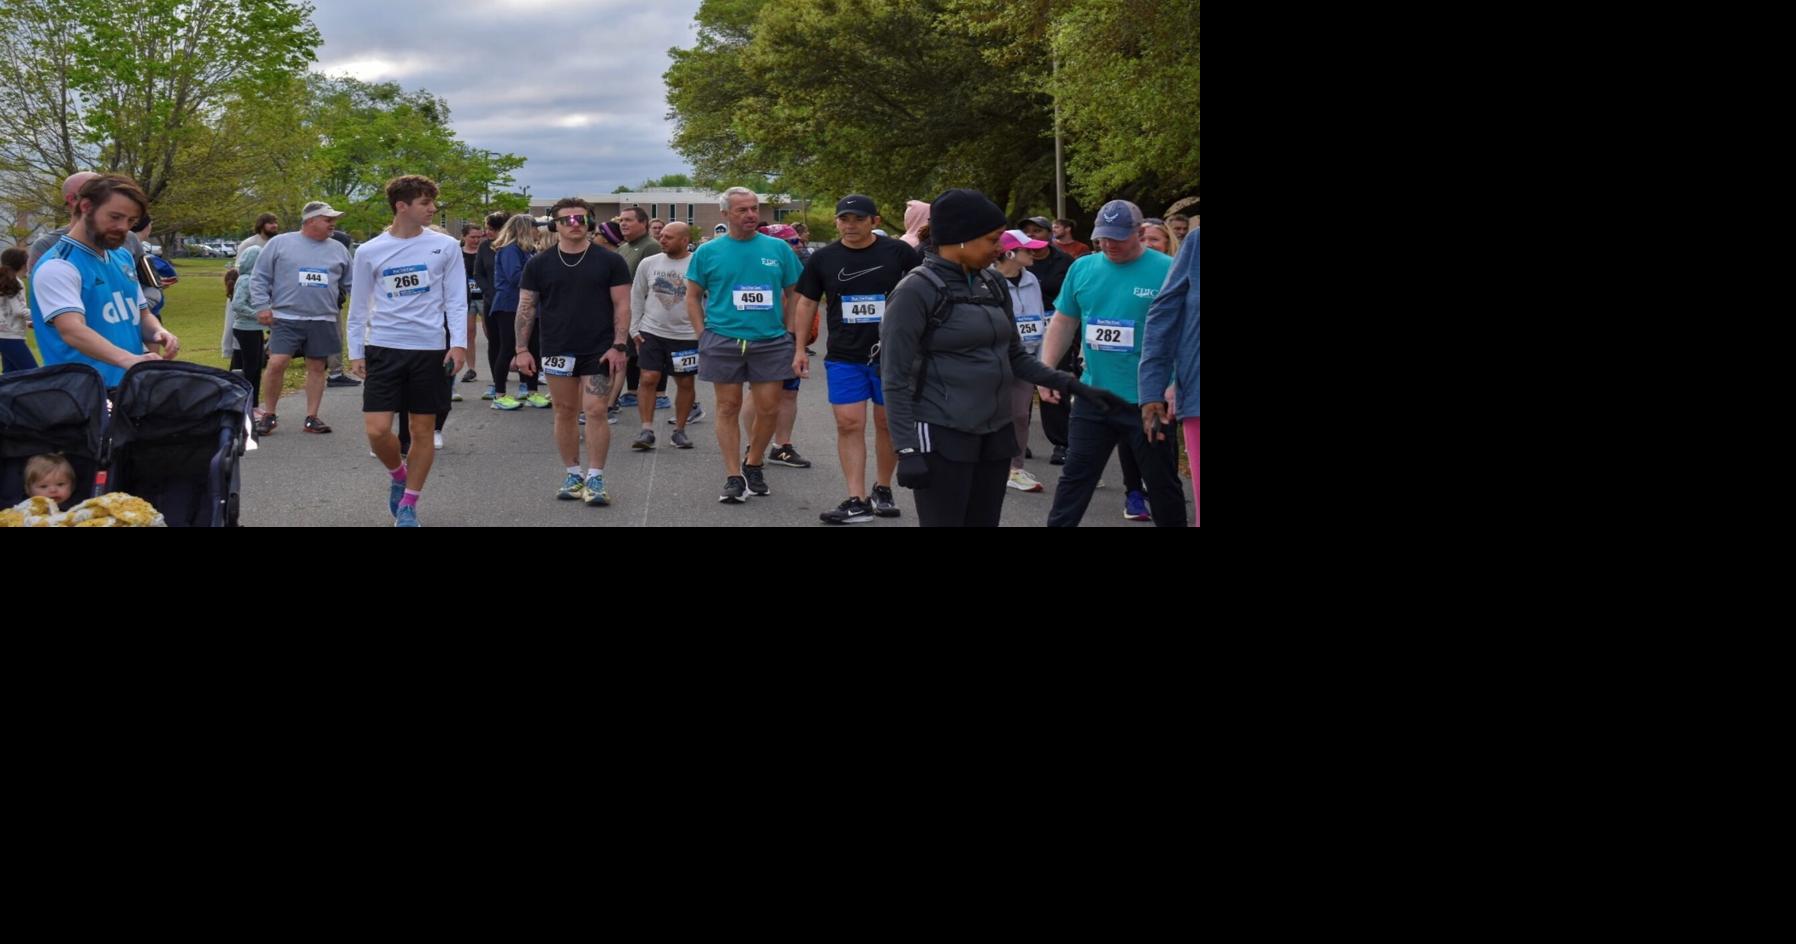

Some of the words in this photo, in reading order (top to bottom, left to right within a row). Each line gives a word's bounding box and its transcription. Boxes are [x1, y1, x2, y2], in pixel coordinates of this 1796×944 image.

[305, 273, 322, 282] 444
[394, 274, 419, 289] 266
[741, 293, 764, 303] 450
[851, 303, 876, 316] 446
[1019, 323, 1038, 334] 254
[1095, 328, 1122, 343] 282
[544, 355, 566, 369] 293
